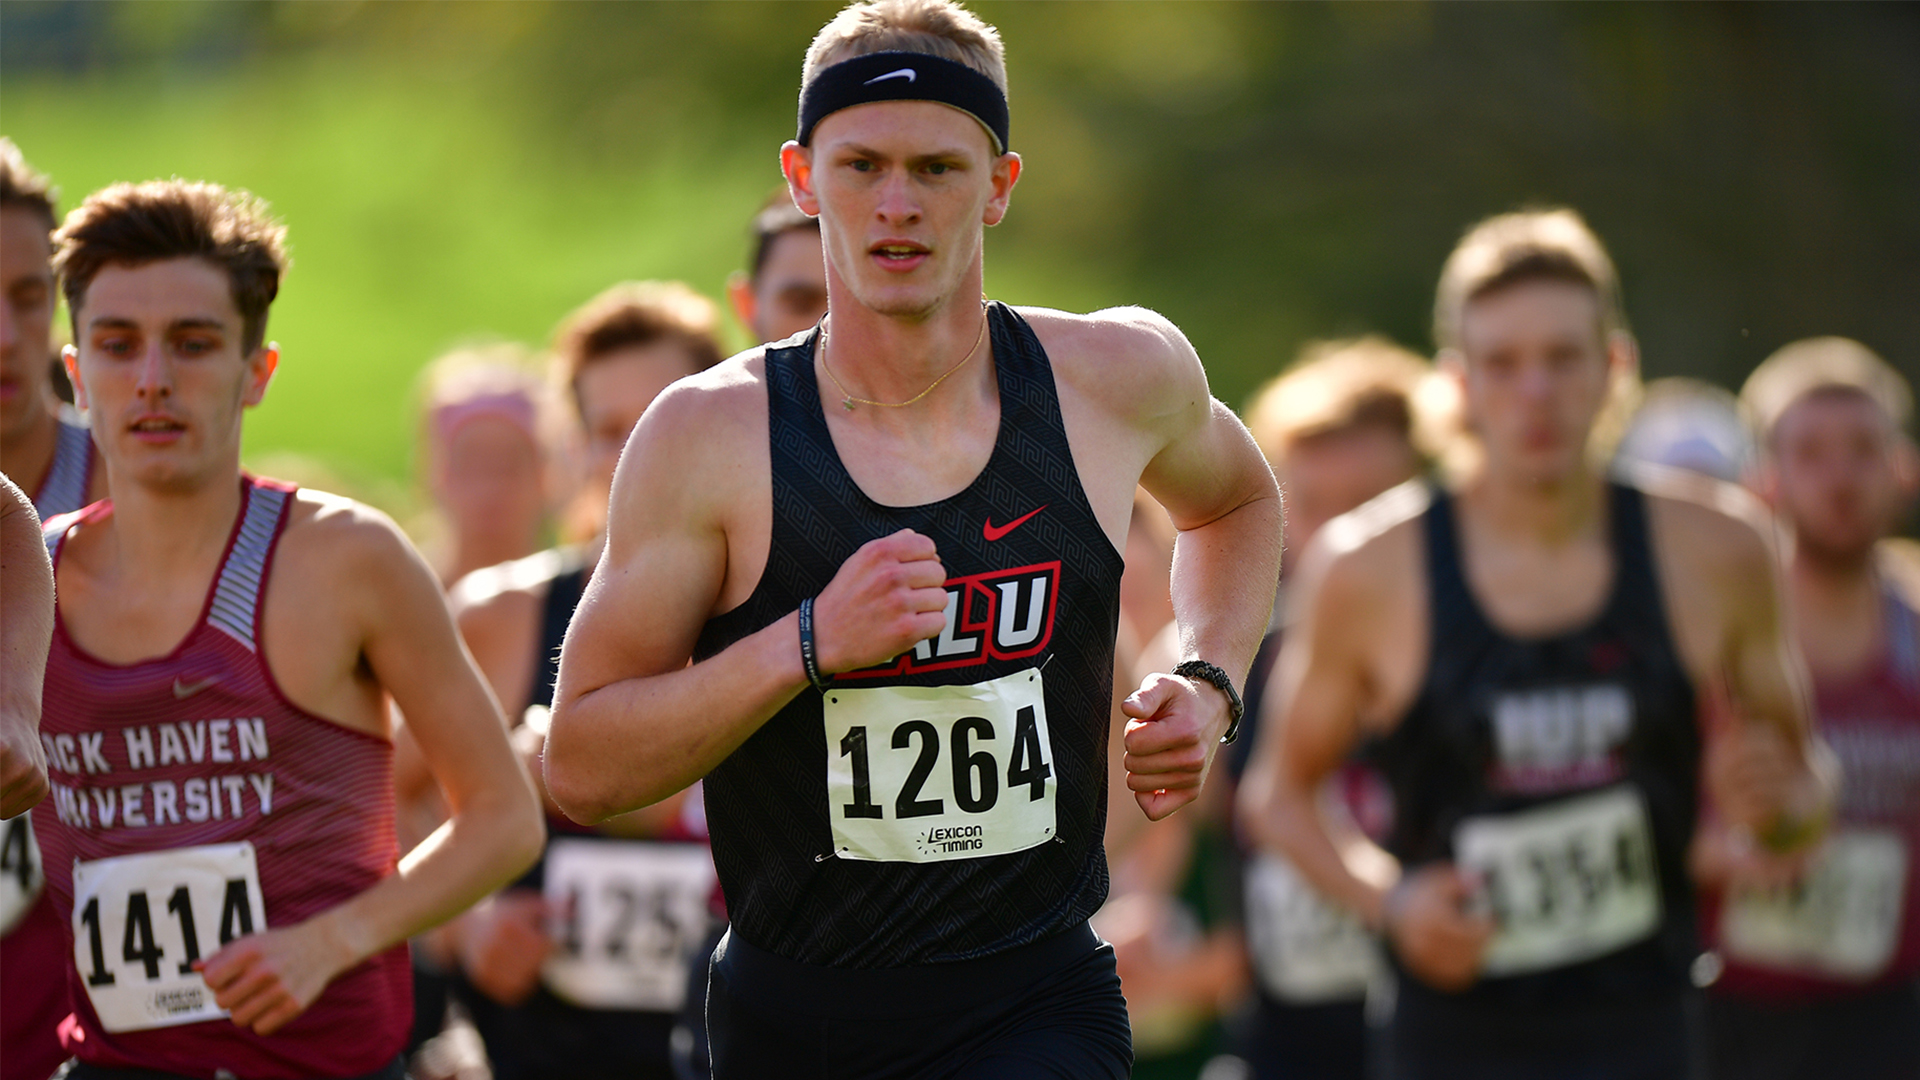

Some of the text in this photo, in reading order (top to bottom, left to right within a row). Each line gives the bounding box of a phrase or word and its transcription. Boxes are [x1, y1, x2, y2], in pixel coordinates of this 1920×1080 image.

[41, 716, 269, 775] OCK HAVEN
[840, 704, 1051, 820] 1264
[928, 825, 983, 844] LEXICON
[936, 838, 983, 853] TIMING
[81, 878, 255, 986] 1414
